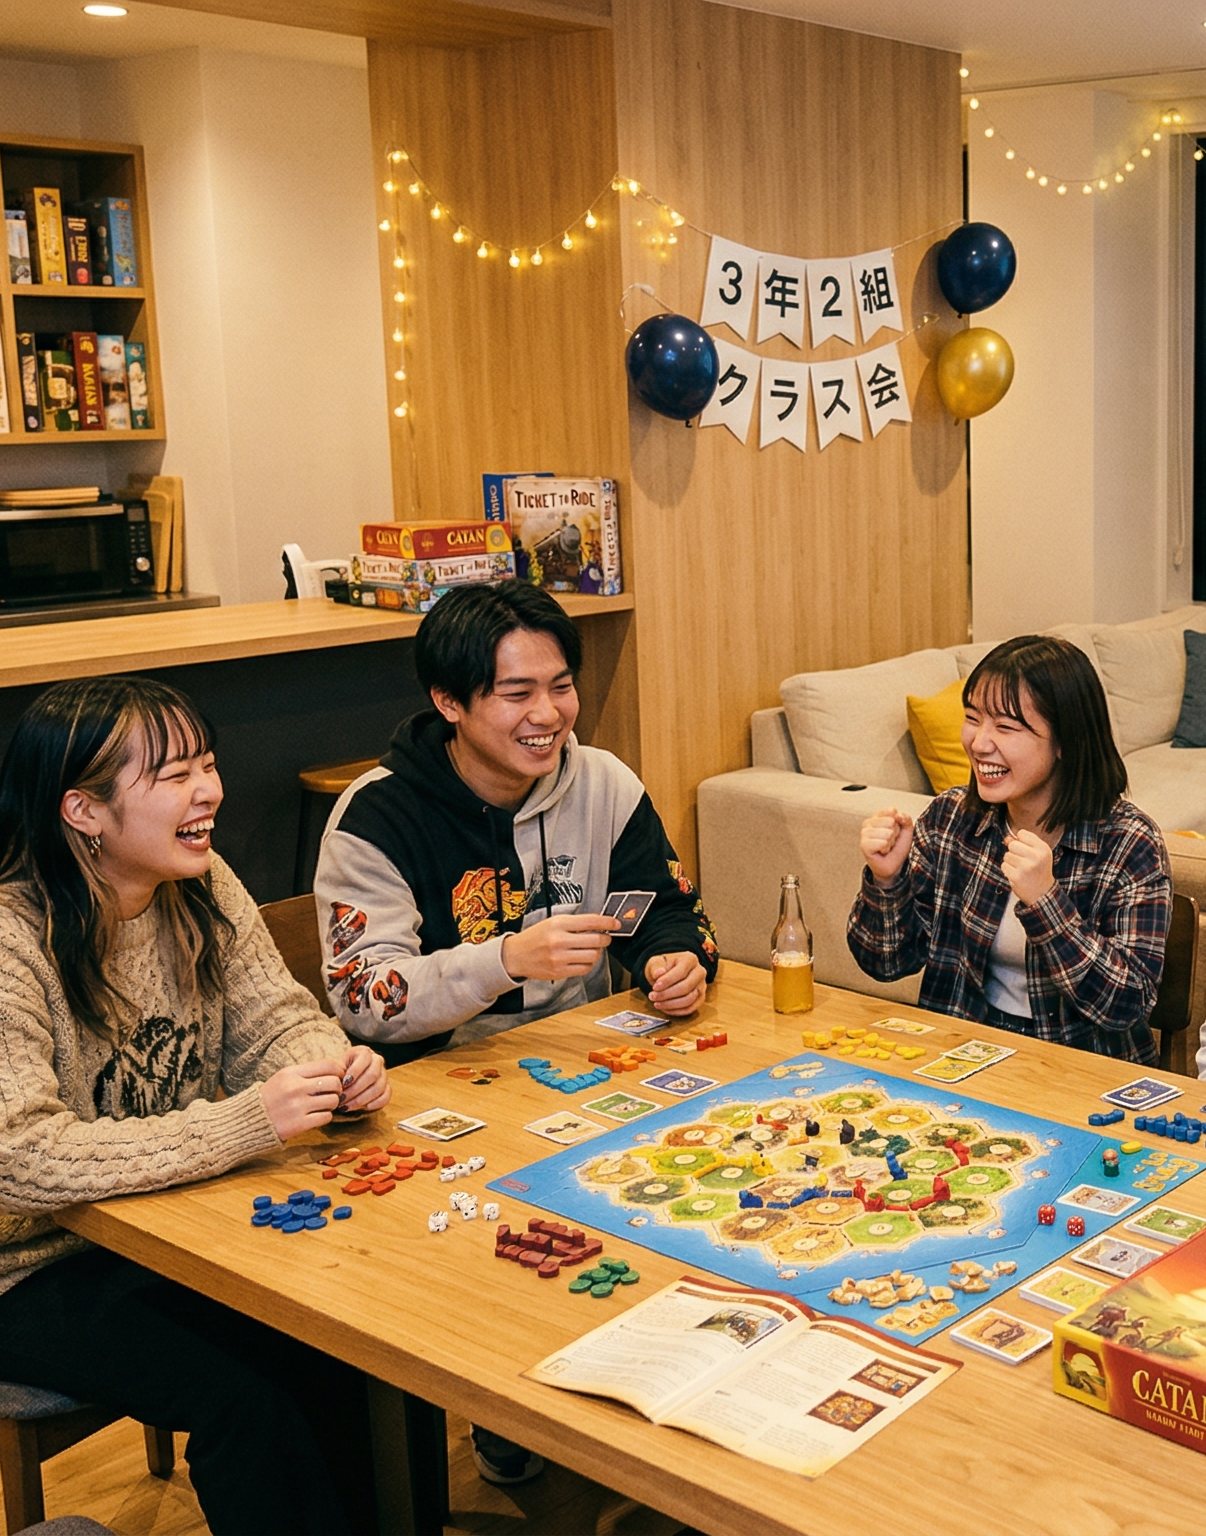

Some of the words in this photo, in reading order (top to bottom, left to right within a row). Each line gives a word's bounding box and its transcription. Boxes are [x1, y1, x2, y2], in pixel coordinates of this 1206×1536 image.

[717, 260, 895, 318] 3年2組
[717, 362, 901, 421] クラス会
[514, 489, 557, 508] TICKET
[571, 488, 596, 507] RIDE
[446, 528, 485, 546] CATAN
